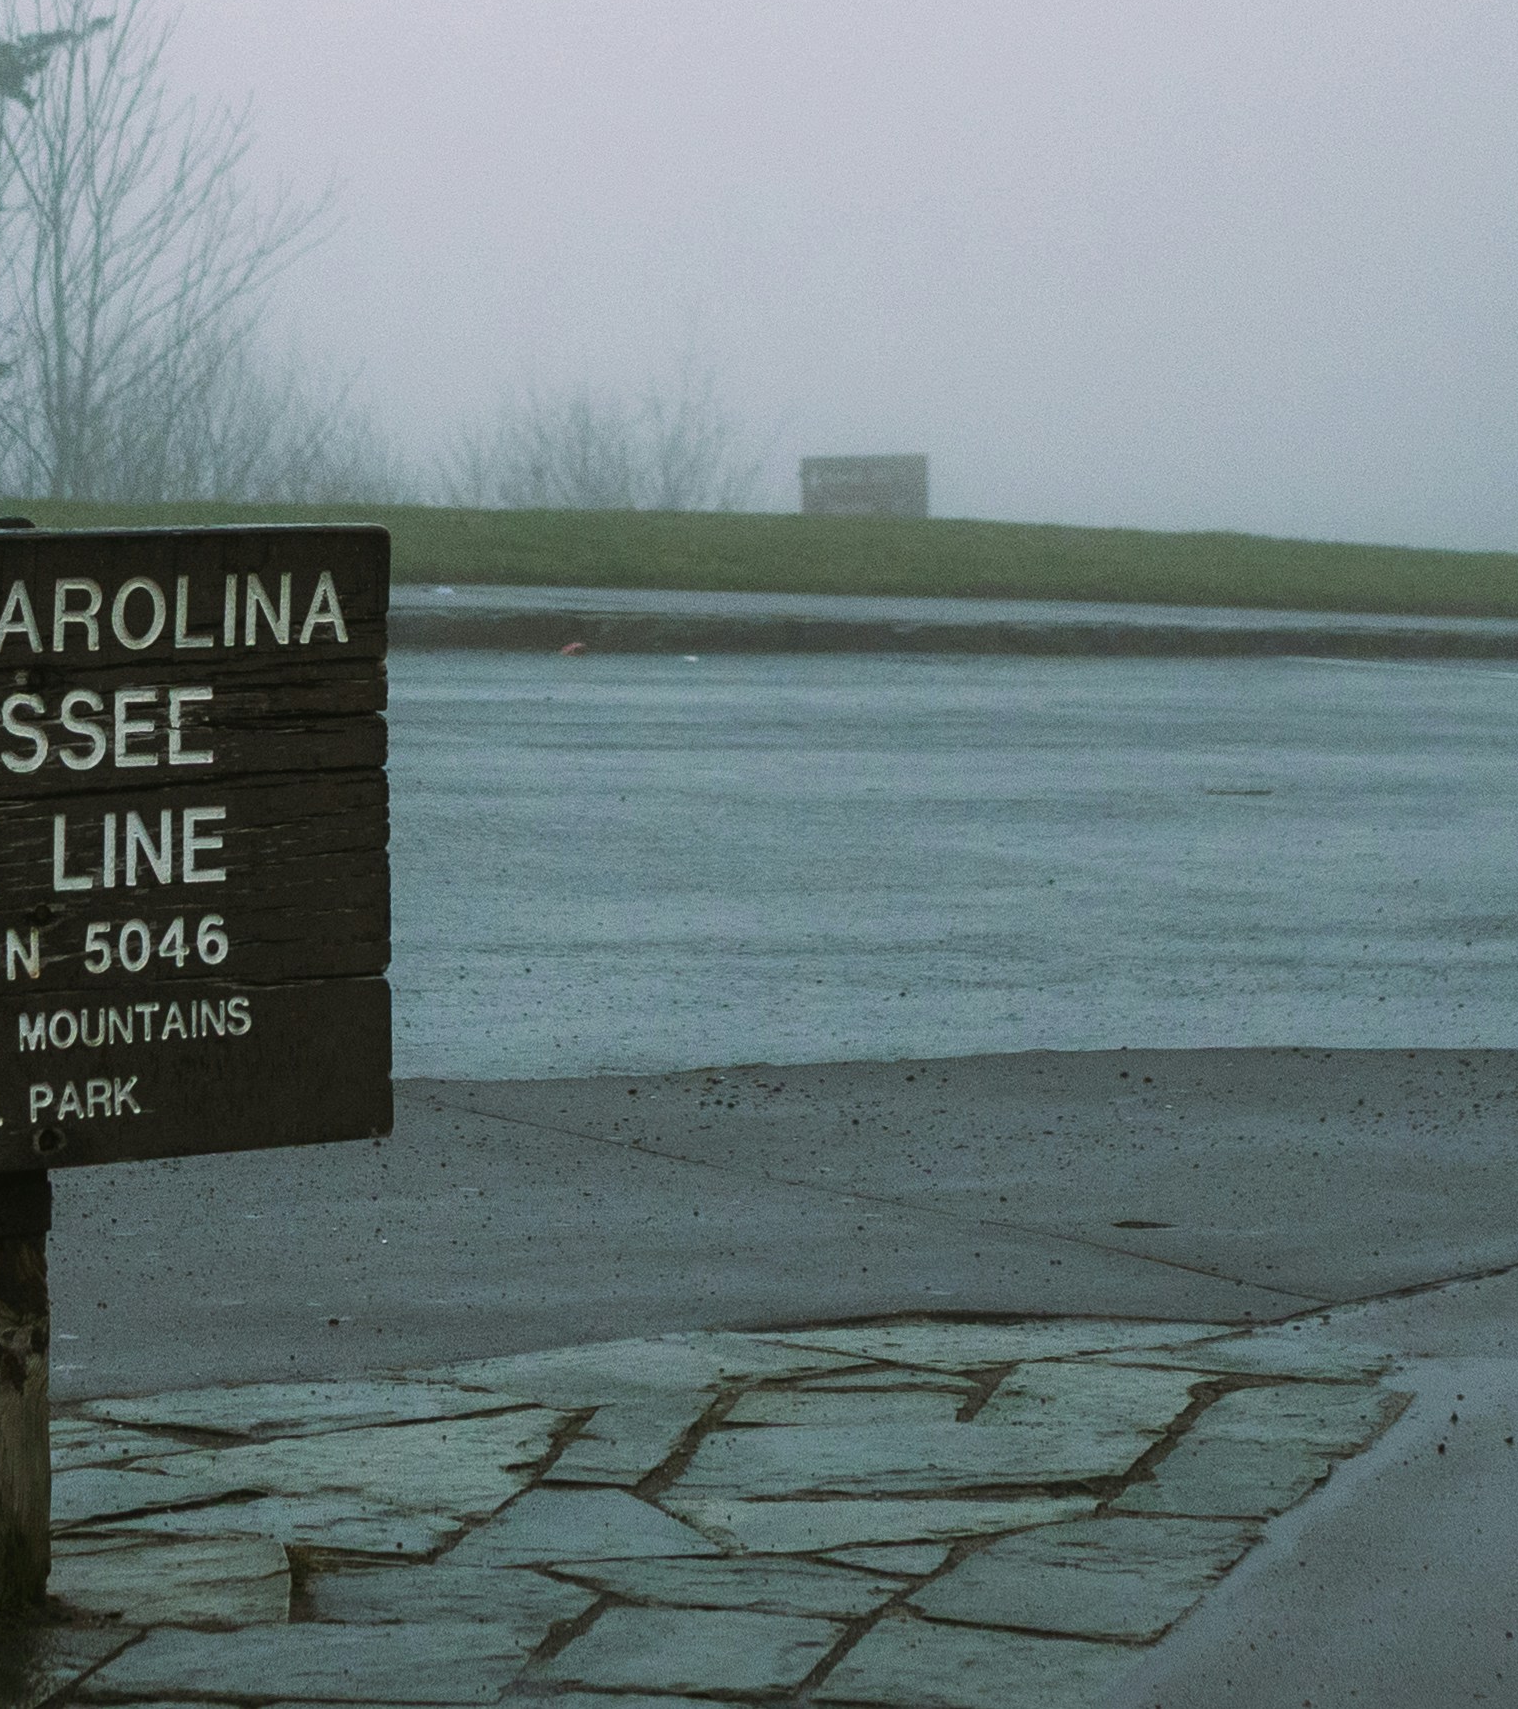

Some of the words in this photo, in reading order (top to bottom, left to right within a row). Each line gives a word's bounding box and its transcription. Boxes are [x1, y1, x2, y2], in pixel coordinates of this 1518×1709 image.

[51, 805, 228, 893] LINE
[83, 915, 229, 975] 5046
[19, 996, 252, 1051] MOUNTAINS
[30, 1077, 141, 1122] PARK
